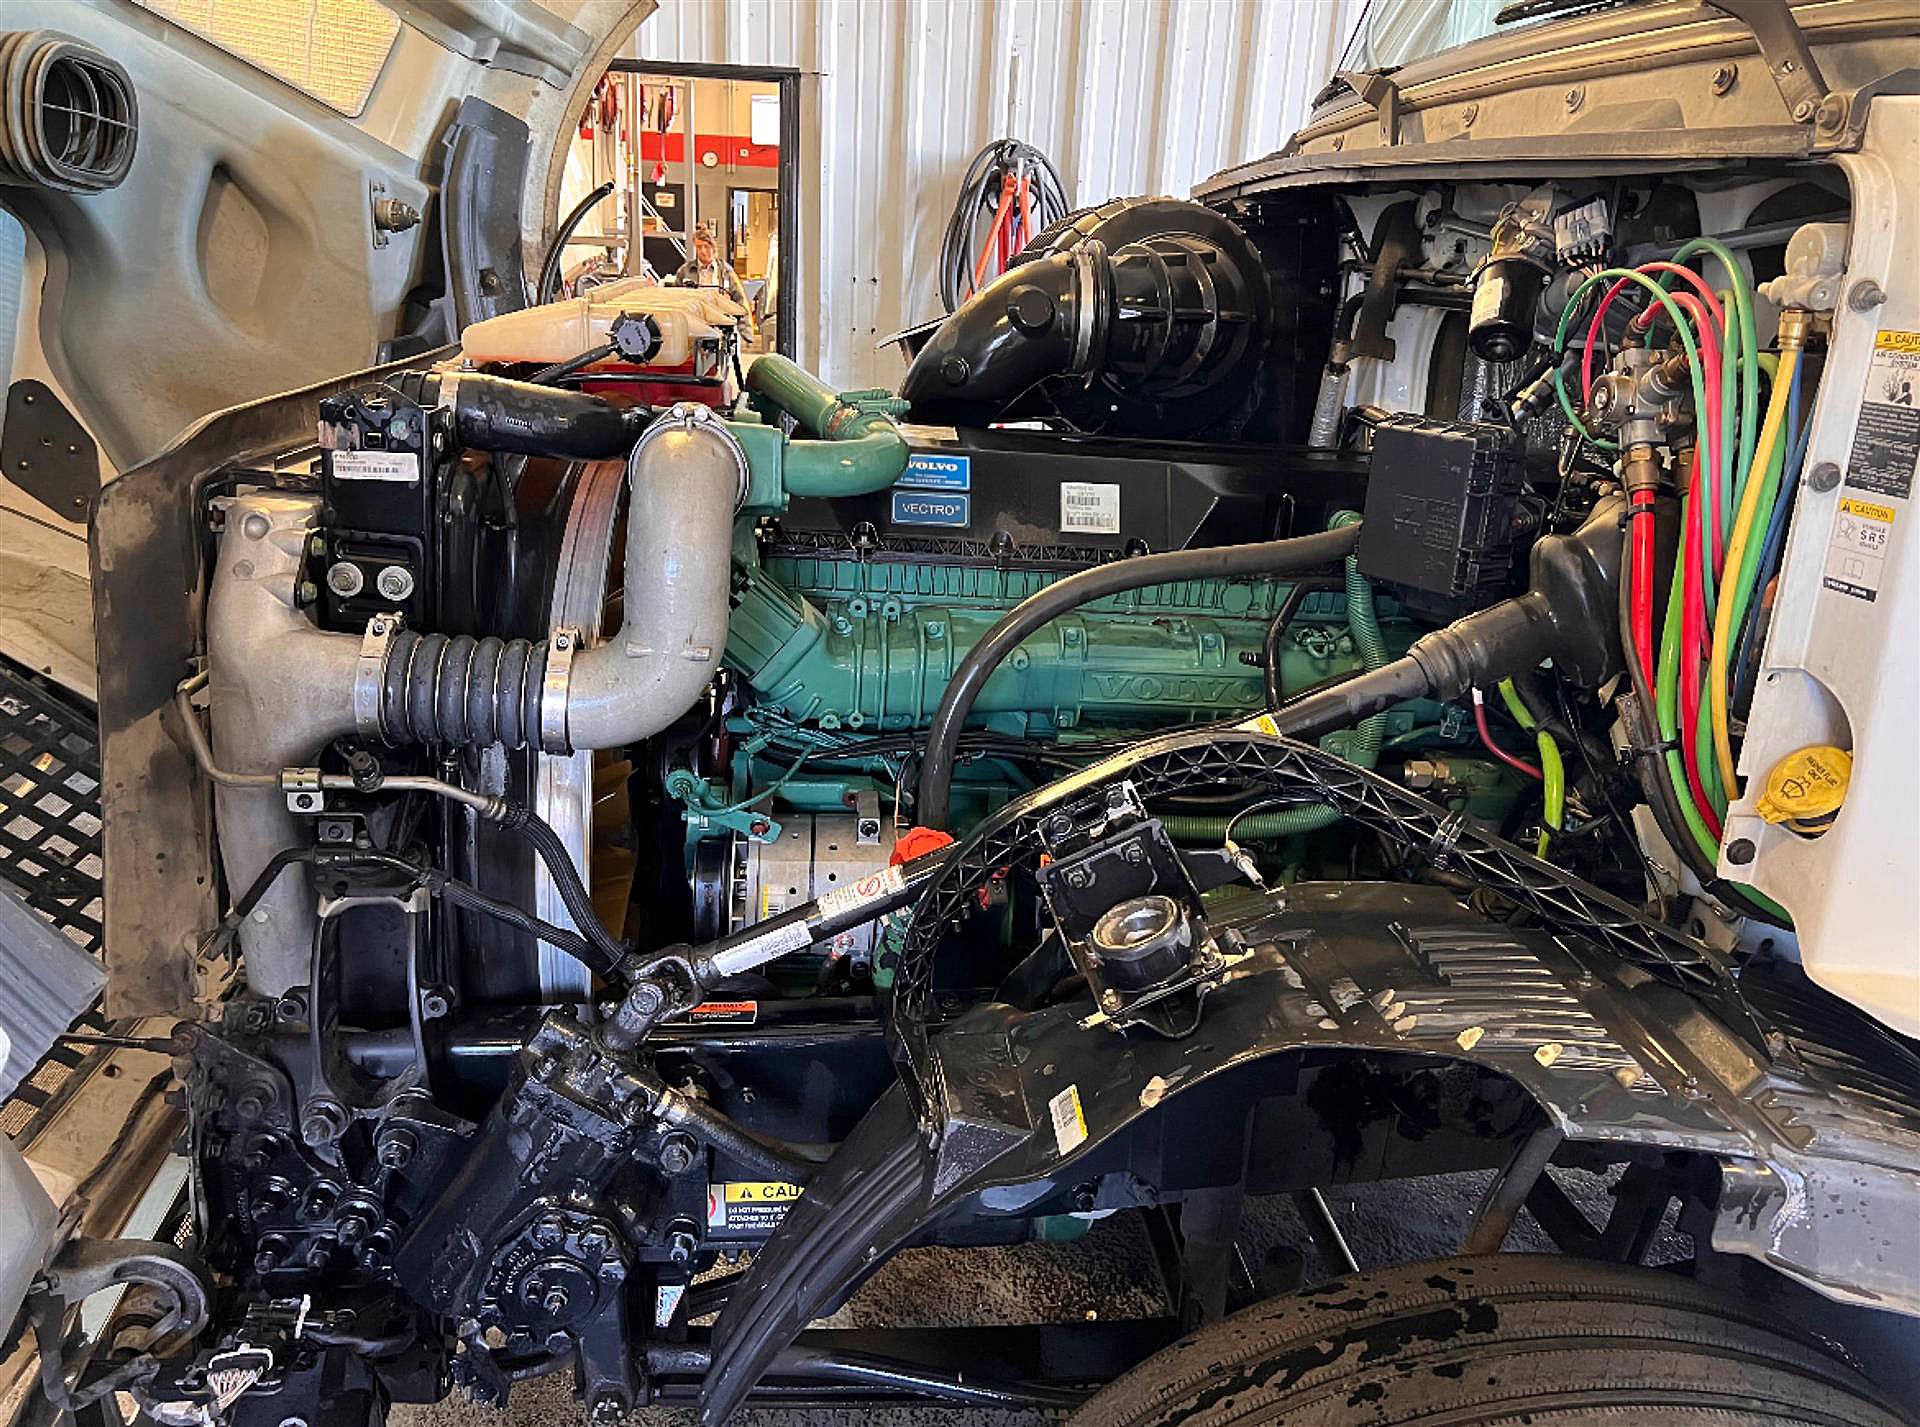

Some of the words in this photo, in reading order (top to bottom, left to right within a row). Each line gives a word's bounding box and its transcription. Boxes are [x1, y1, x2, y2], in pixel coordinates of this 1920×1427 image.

[1895, 334, 1920, 345] CAUT
[907, 461, 958, 472] VOLVO
[1854, 504, 1889, 520] CAUTION
[1860, 529, 1886, 544] SRS
[1091, 674, 1264, 704] VOLVO
